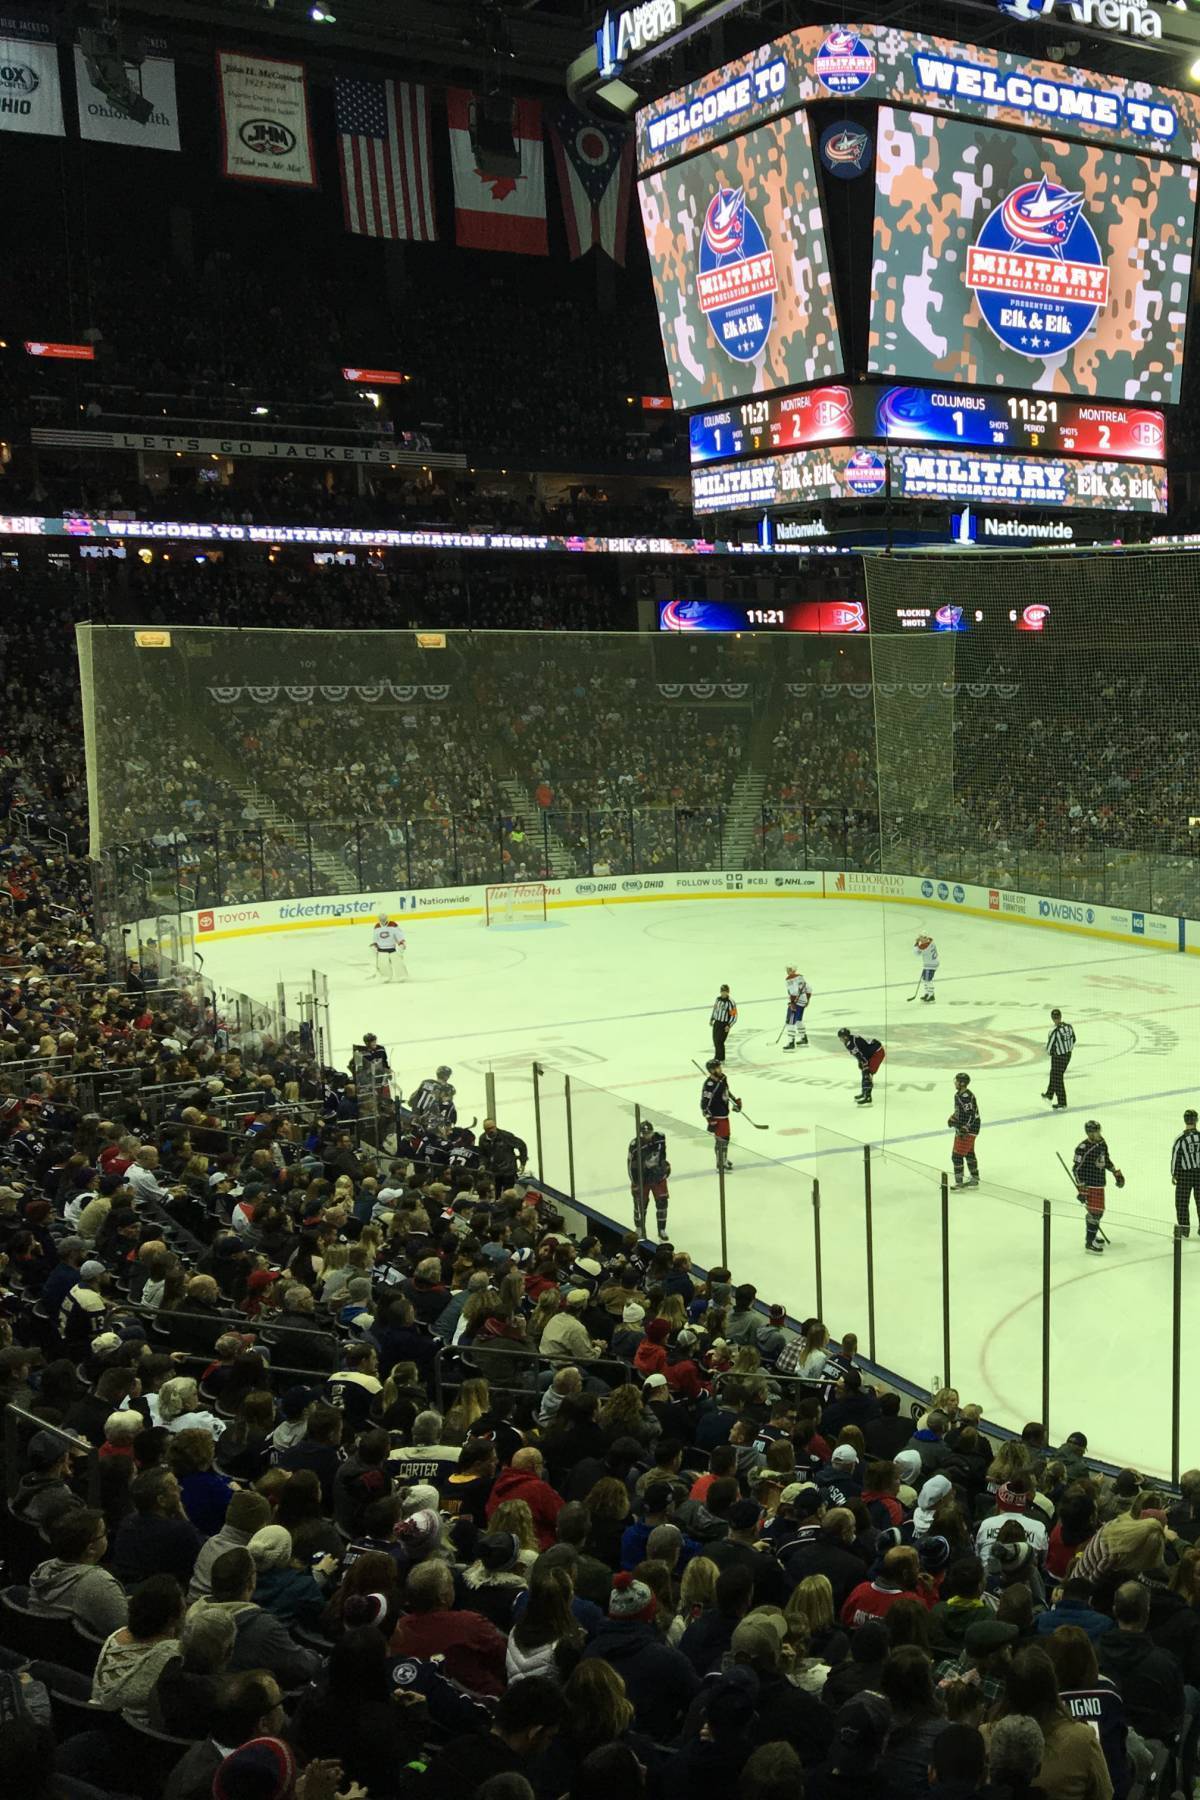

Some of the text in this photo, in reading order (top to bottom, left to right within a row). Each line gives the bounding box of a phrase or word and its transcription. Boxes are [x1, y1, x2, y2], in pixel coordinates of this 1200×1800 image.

[0, 66, 26, 83] OX
[0, 97, 31, 115] HIO
[650, 61, 786, 150] WELCOME TO
[916, 58, 1174, 136] WELCOME TO
[700, 258, 772, 296] MILITARY
[972, 253, 1105, 289] MILITARY
[703, 280, 775, 307] APPRECIATION NIGHT
[972, 274, 1104, 300] APPRECIATION NIGHT
[1010, 299, 1065, 313] PRESENTED BY
[723, 313, 764, 340] Elk & Elk
[1000, 309, 1072, 334] Elk & Elk
[781, 396, 811, 411] MONTREAL
[931, 393, 985, 411] COLUMBUS
[1007, 397, 1058, 423] 11:21
[704, 412, 731, 428] COLUMBUS
[741, 400, 770, 425] 11:21
[1079, 407, 1128, 424] MONTREAL
[792, 414, 800, 438] 2
[952, 411, 963, 436] 1
[989, 420, 1009, 431] SHOTS
[1023, 423, 1046, 434] PERIOD
[1059, 426, 1078, 437] SHOTS
[714, 429, 721, 451] 1
[754, 435, 760, 448] 3
[1031, 434, 1039, 447] 3
[1098, 426, 1111, 448] 2
[123, 435, 391, 462] LET'S GO JACKETS
[781, 463, 837, 490] Elk & Elk
[905, 456, 1066, 488] MILITARY
[694, 466, 776, 497] MILITARY
[905, 480, 1066, 501] APPRECIATION NIGHT
[1077, 474, 1157, 499] Elk & Elk
[695, 488, 776, 509] APPRECIATION NIGHT
[107, 523, 549, 549] WELCOME TO MILITARY APPRECIATION NIGHT
[984, 518, 1073, 539] Nationwide
[608, 538, 673, 554] Elk & Elk
[746, 609, 785, 624] 11:21
[896, 608, 931, 618] BLOCKED
[975, 611, 983, 622] 9
[1009, 611, 1017, 622] 6
[902, 618, 926, 627] SHOTS
[597, 883, 617, 892] OHIO
[643, 880, 664, 889] OHIO
[676, 878, 724, 887] FOLLOW US
[848, 873, 904, 887] ELDORADO
[279, 900, 375, 919] ticketmaster
[420, 896, 470, 906] Nationwide
[218, 911, 260, 925] TOYOTA
[400, 1462, 439, 1477] CARTER
